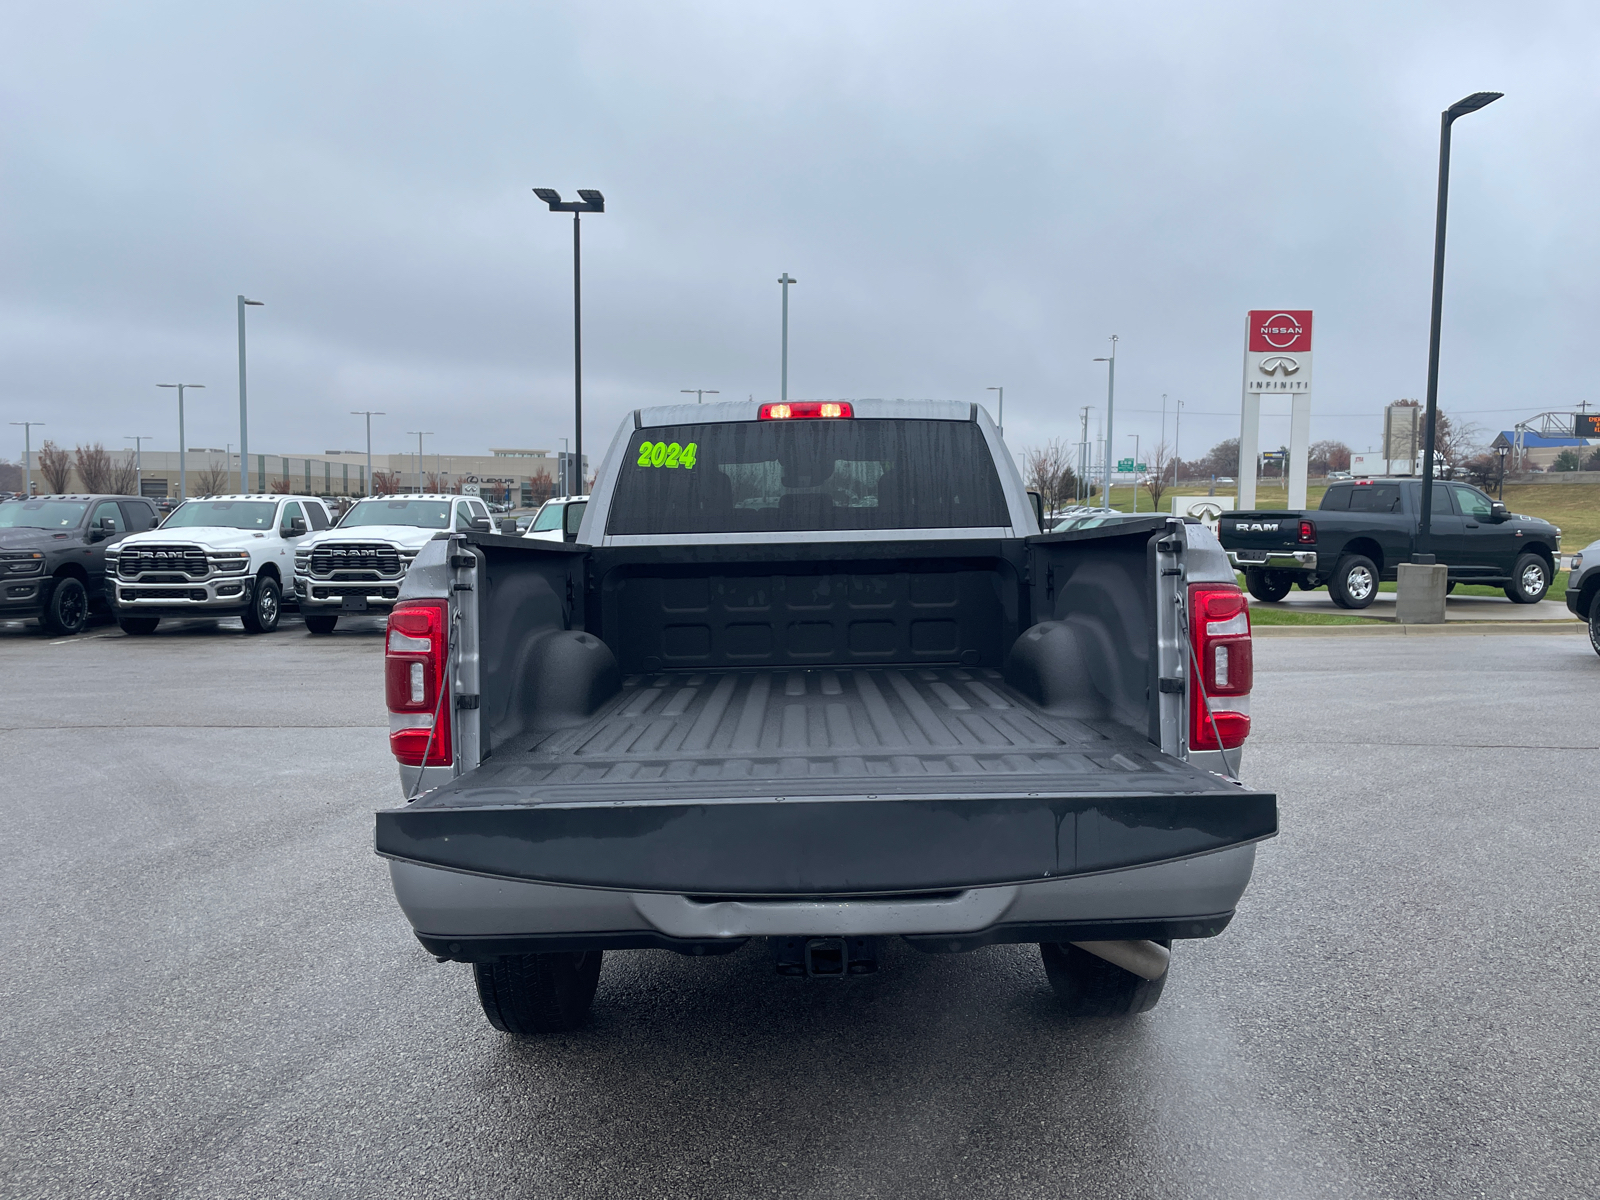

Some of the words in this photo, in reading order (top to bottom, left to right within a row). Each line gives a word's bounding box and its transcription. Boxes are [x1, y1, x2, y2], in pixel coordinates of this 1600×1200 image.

[1249, 381, 1308, 389] INFINITI
[637, 441, 698, 469] 2024
[1235, 523, 1279, 531] RAM
